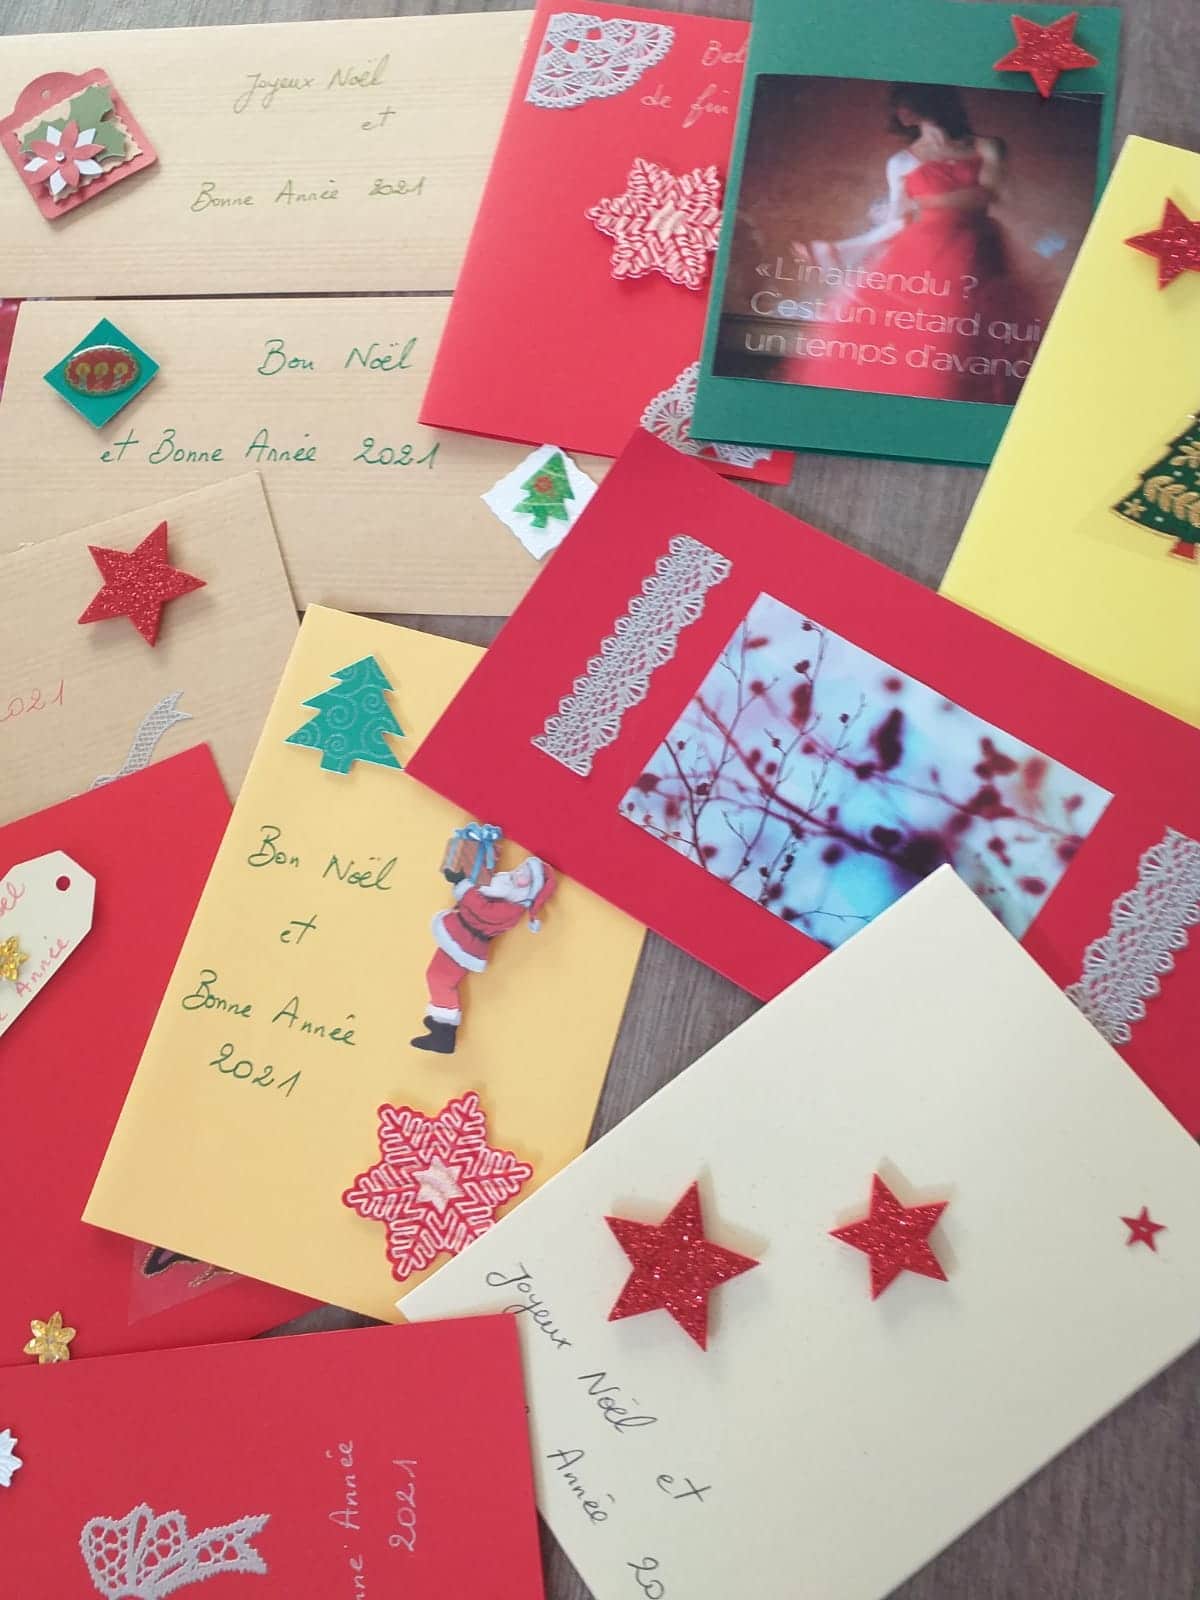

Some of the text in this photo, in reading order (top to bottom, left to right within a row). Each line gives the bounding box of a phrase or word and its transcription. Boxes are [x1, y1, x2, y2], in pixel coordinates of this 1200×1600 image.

[233, 54, 390, 114] Joyeux Noël
[640, 83, 729, 128] de fin
[361, 106, 396, 130] et
[190, 176, 427, 212] Bonne Année 2021
[959, 274, 979, 298] ?
[836, 303, 876, 326] un
[884, 309, 981, 337] retard
[988, 318, 1041, 344] qui
[257, 337, 418, 375] Bon Noël
[744, 332, 786, 353] un
[795, 332, 898, 366] temps
[100, 428, 440, 469] et Bonne Année 2021
[0, 679, 64, 723] 021
[248, 825, 398, 890] Bon Noël
[280, 914, 318, 944] et
[181, 969, 356, 1046] Bonne Année
[209, 1043, 301, 1097] 2021
[486, 1262, 711, 1502] Joyeux Noël et
[325, 1440, 360, 1530] Année
[388, 1459, 418, 1552] 2021
[547, 1449, 665, 1600] Année 20
